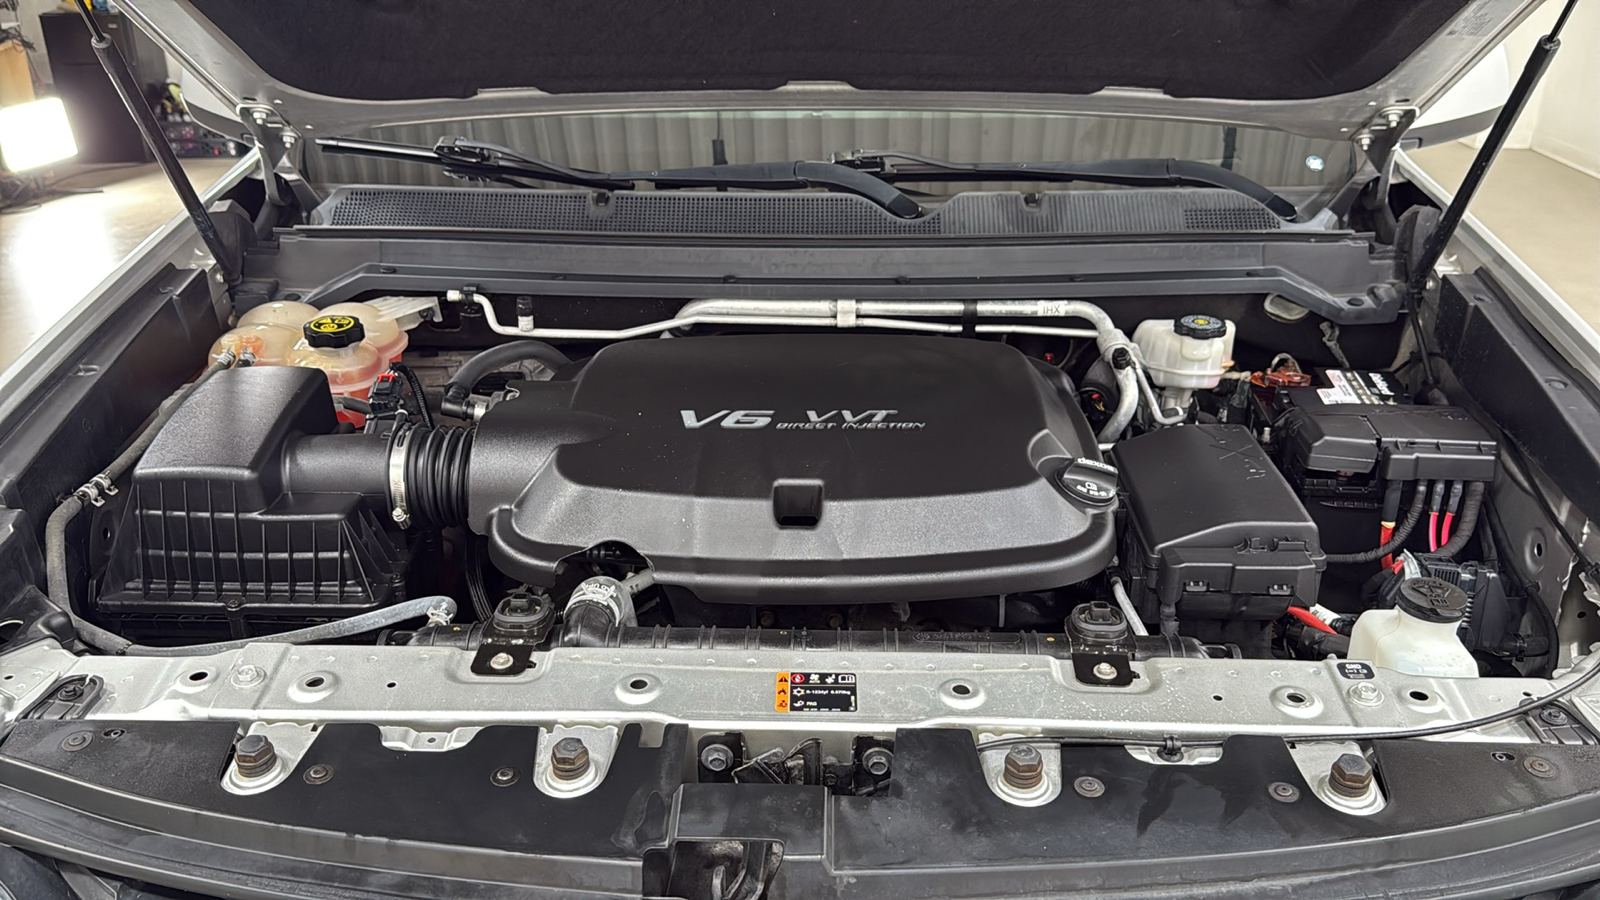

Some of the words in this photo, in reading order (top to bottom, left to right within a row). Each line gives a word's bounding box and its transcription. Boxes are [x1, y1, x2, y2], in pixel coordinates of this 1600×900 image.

[680, 409, 776, 430] V6
[806, 409, 899, 423] VVT
[775, 421, 838, 430] DIRECT
[841, 421, 926, 430] INJECTION
